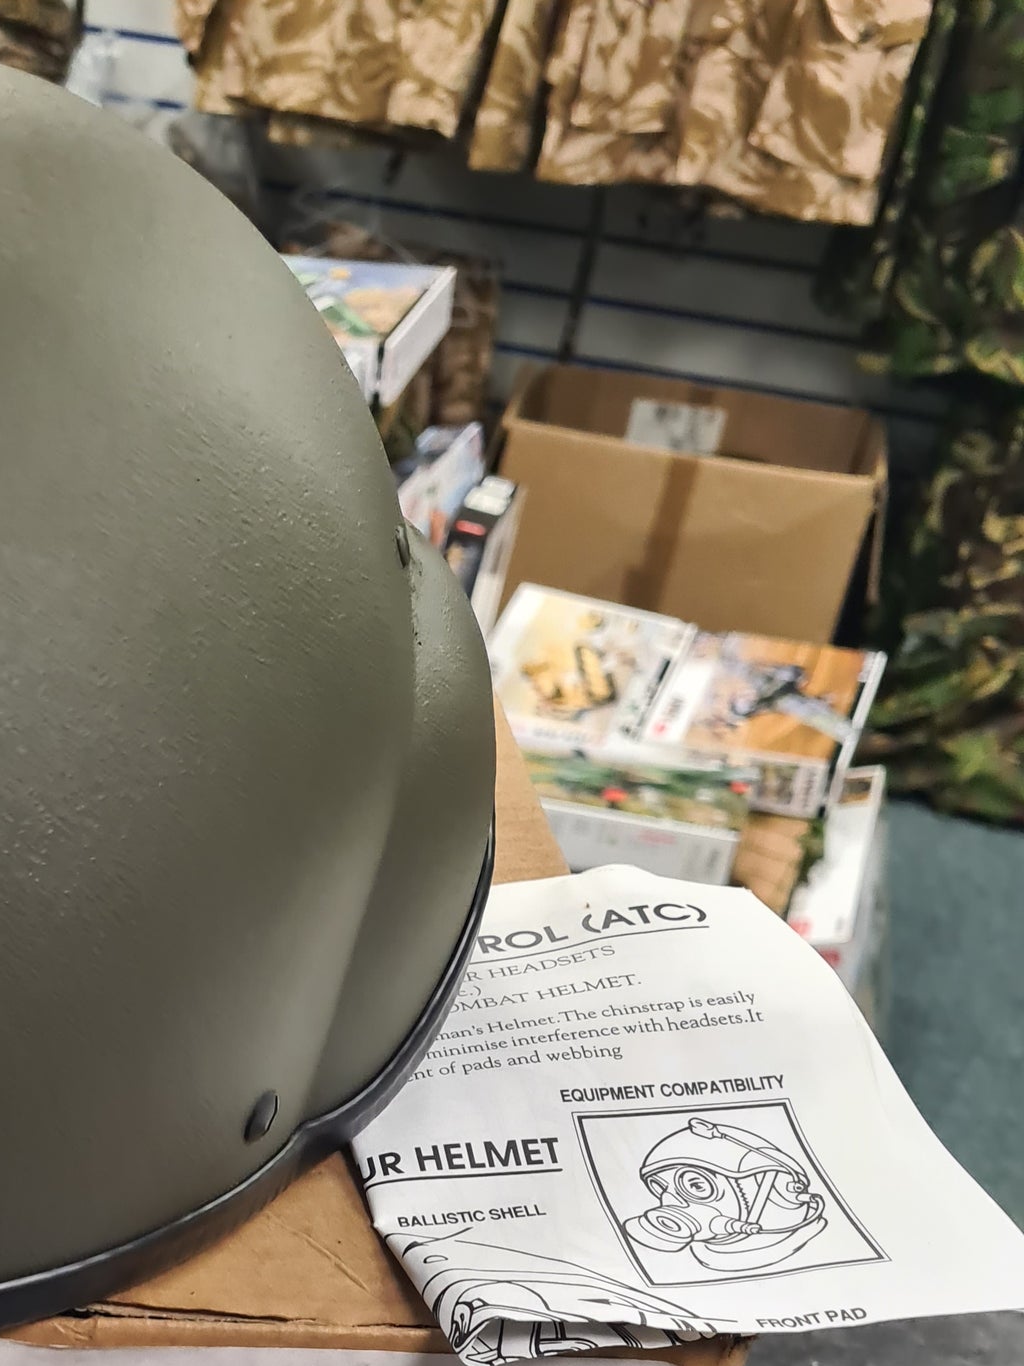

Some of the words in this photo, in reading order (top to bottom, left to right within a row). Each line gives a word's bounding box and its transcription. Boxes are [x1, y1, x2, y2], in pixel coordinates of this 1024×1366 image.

[582, 902, 707, 933] (ATC)
[488, 944, 617, 979] HEADSETS
[537, 973, 642, 1001] HELMET.
[601, 998, 685, 1018] chinstrap
[688, 996, 703, 1008] is
[707, 990, 756, 1006] easily
[426, 1040, 509, 1060] minimise
[512, 1026, 621, 1047] interference
[623, 1018, 665, 1034] with
[439, 1061, 456, 1076] of
[462, 1056, 502, 1075] pads
[507, 1050, 541, 1067] and
[546, 1045, 624, 1062] webbing
[560, 1084, 655, 1103] EQUIPMENT
[660, 1074, 785, 1097] COMPATIBILITY
[416, 1137, 559, 1172] HELMET
[397, 1209, 487, 1228] BALLISTIC
[488, 1203, 547, 1222] SHELL
[756, 1312, 821, 1330] FRONT
[826, 1307, 867, 1323] PAD
